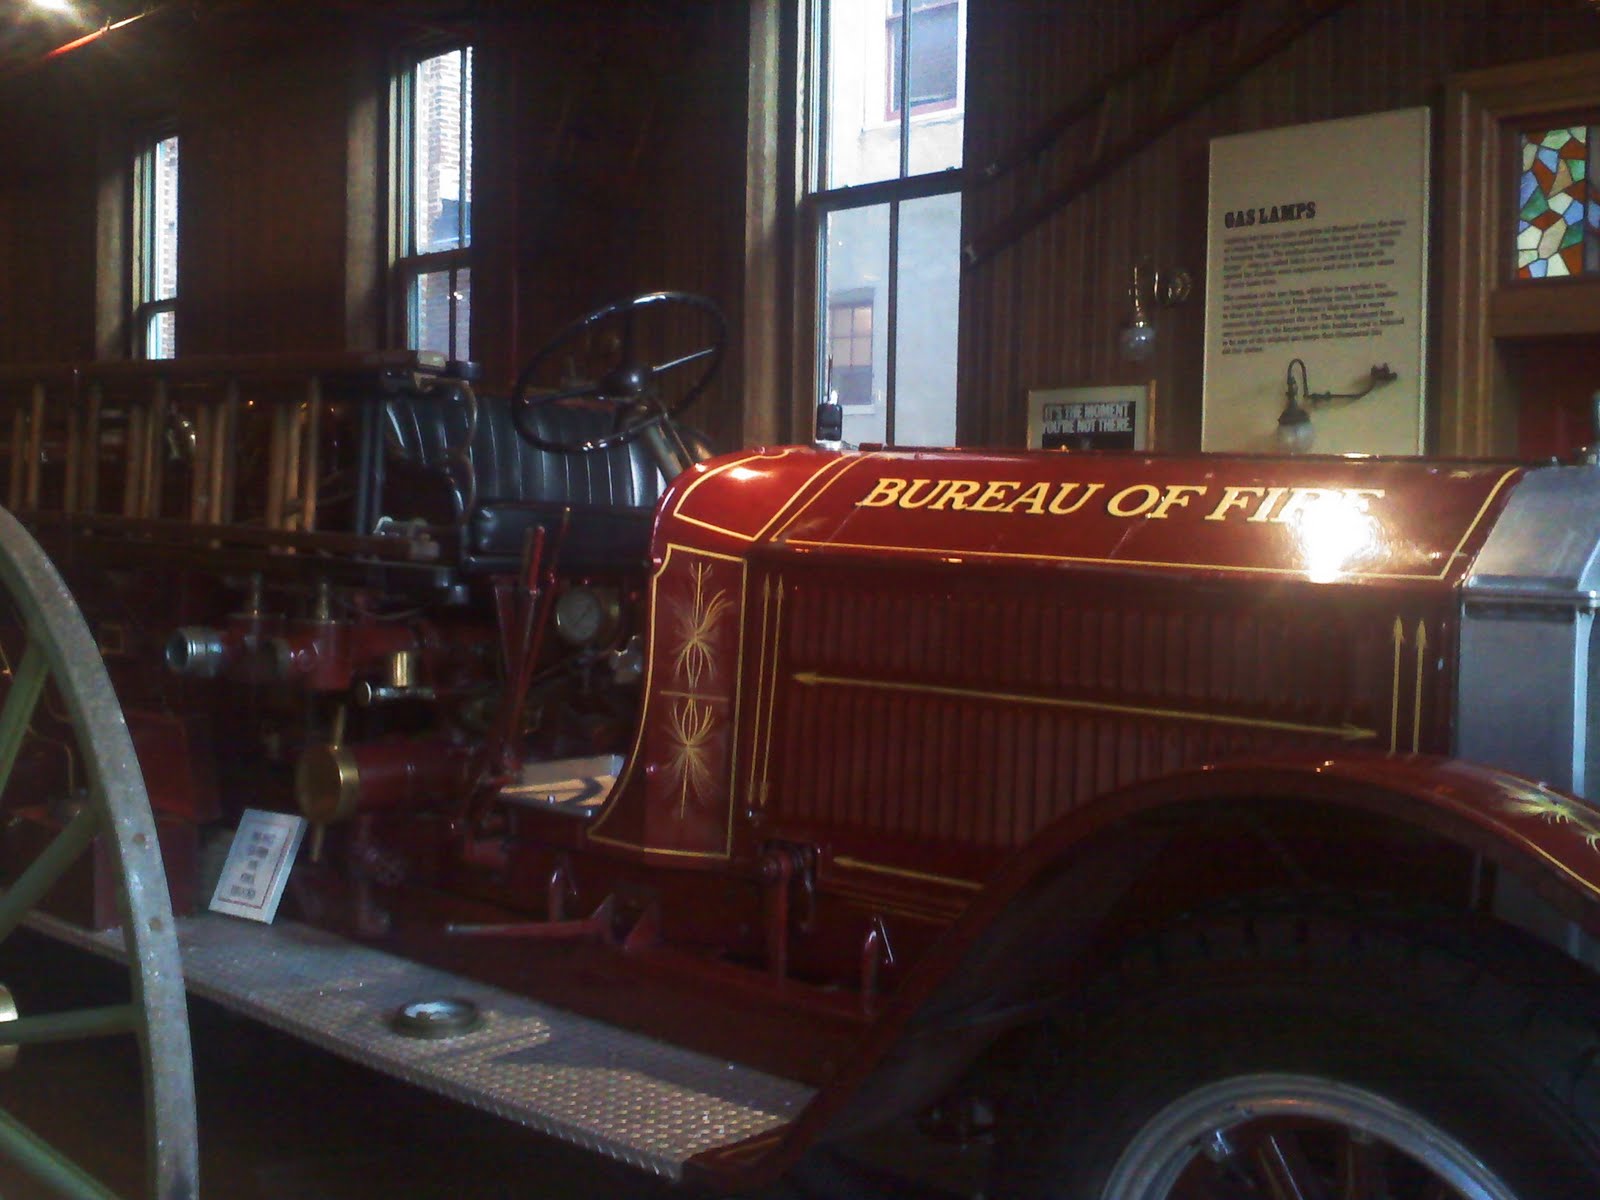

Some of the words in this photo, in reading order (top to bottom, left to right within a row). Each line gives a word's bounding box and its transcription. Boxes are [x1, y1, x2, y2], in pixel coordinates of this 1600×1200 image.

[1224, 208, 1255, 229] GAS
[1258, 201, 1316, 224] LAMPS
[1064, 404, 1082, 419] THE
[1084, 403, 1128, 418] MOMENT
[1077, 419, 1095, 432] NOT
[855, 477, 1105, 515] BUREAU
[1106, 484, 1208, 518] OF
